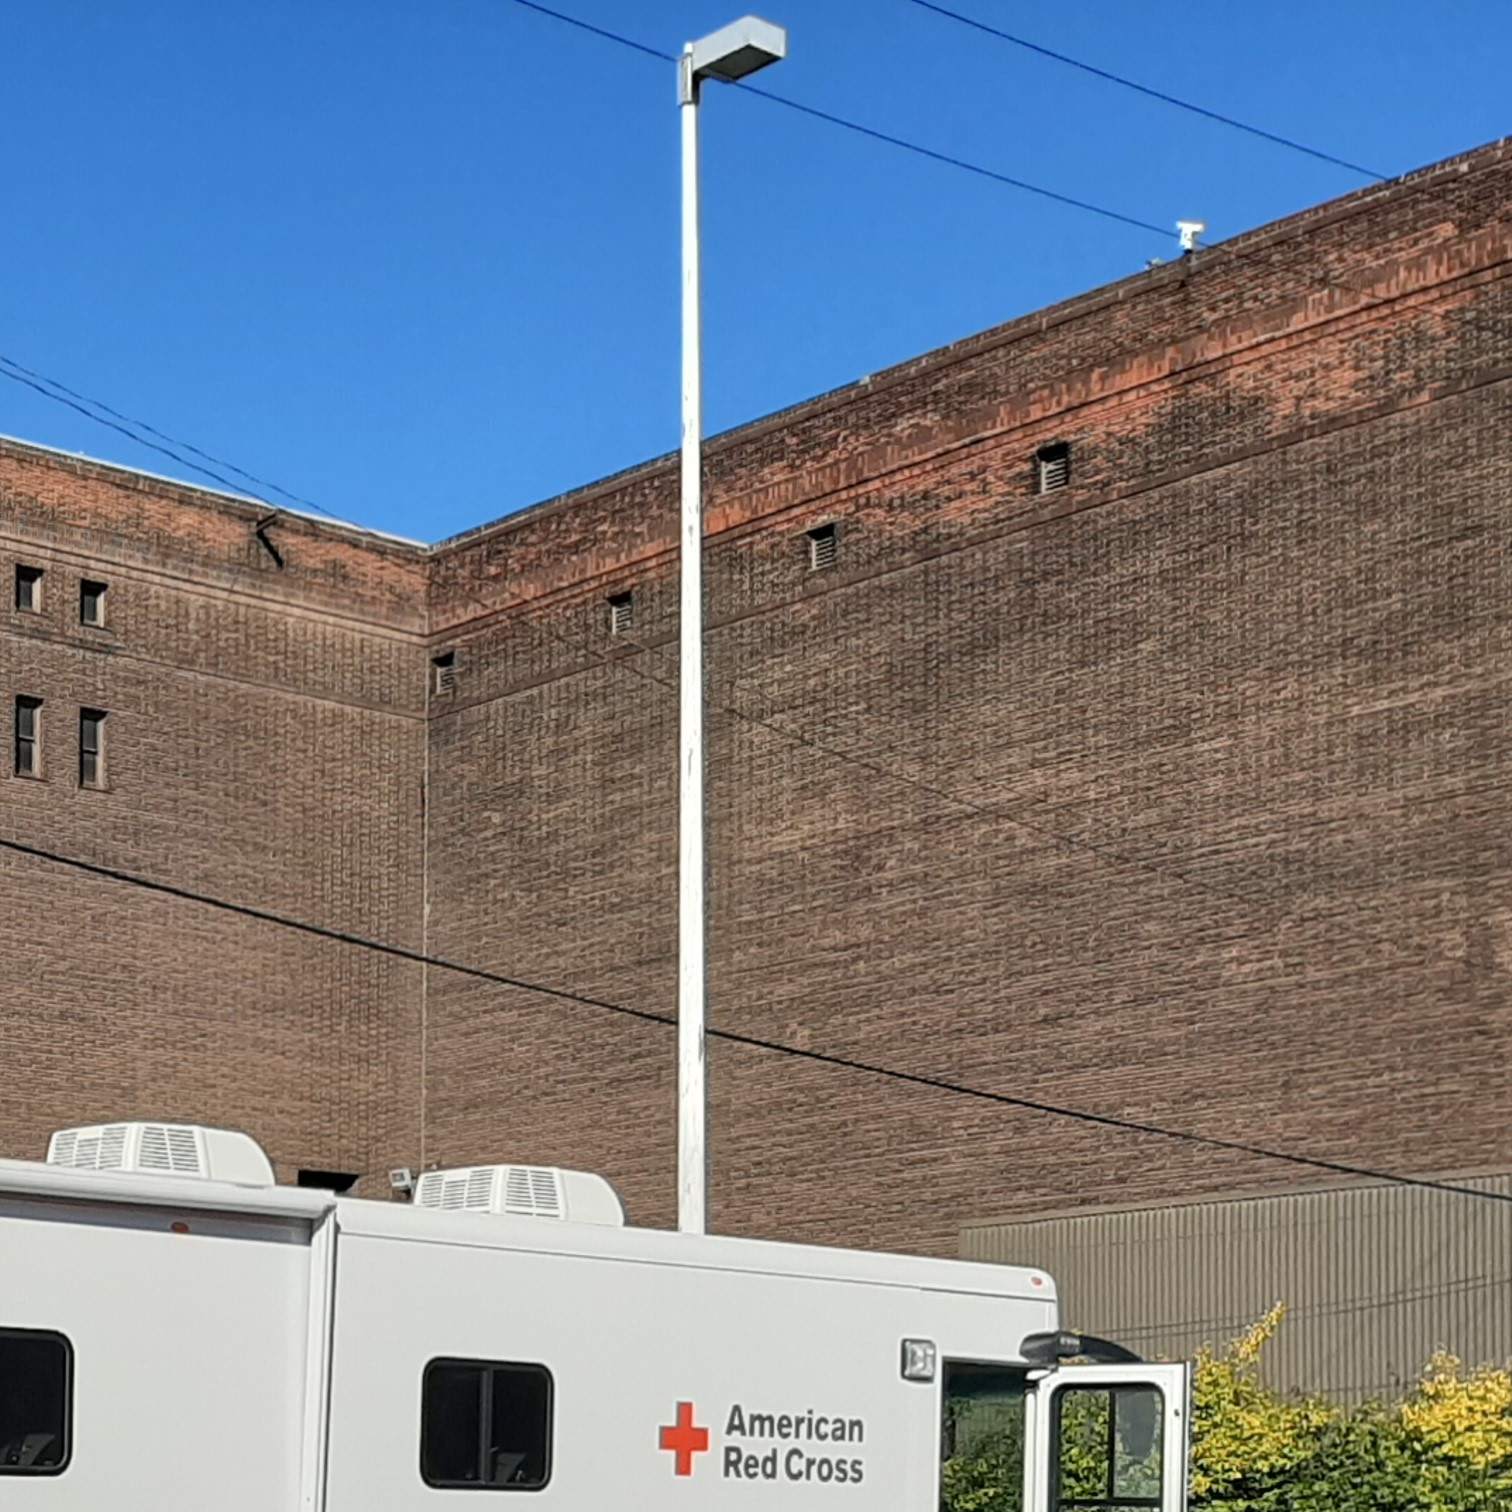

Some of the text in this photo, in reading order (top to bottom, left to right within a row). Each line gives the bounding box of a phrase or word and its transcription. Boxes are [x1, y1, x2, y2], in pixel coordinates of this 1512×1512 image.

[724, 1403, 864, 1443] American
[723, 1446, 864, 1483] Red Cross
